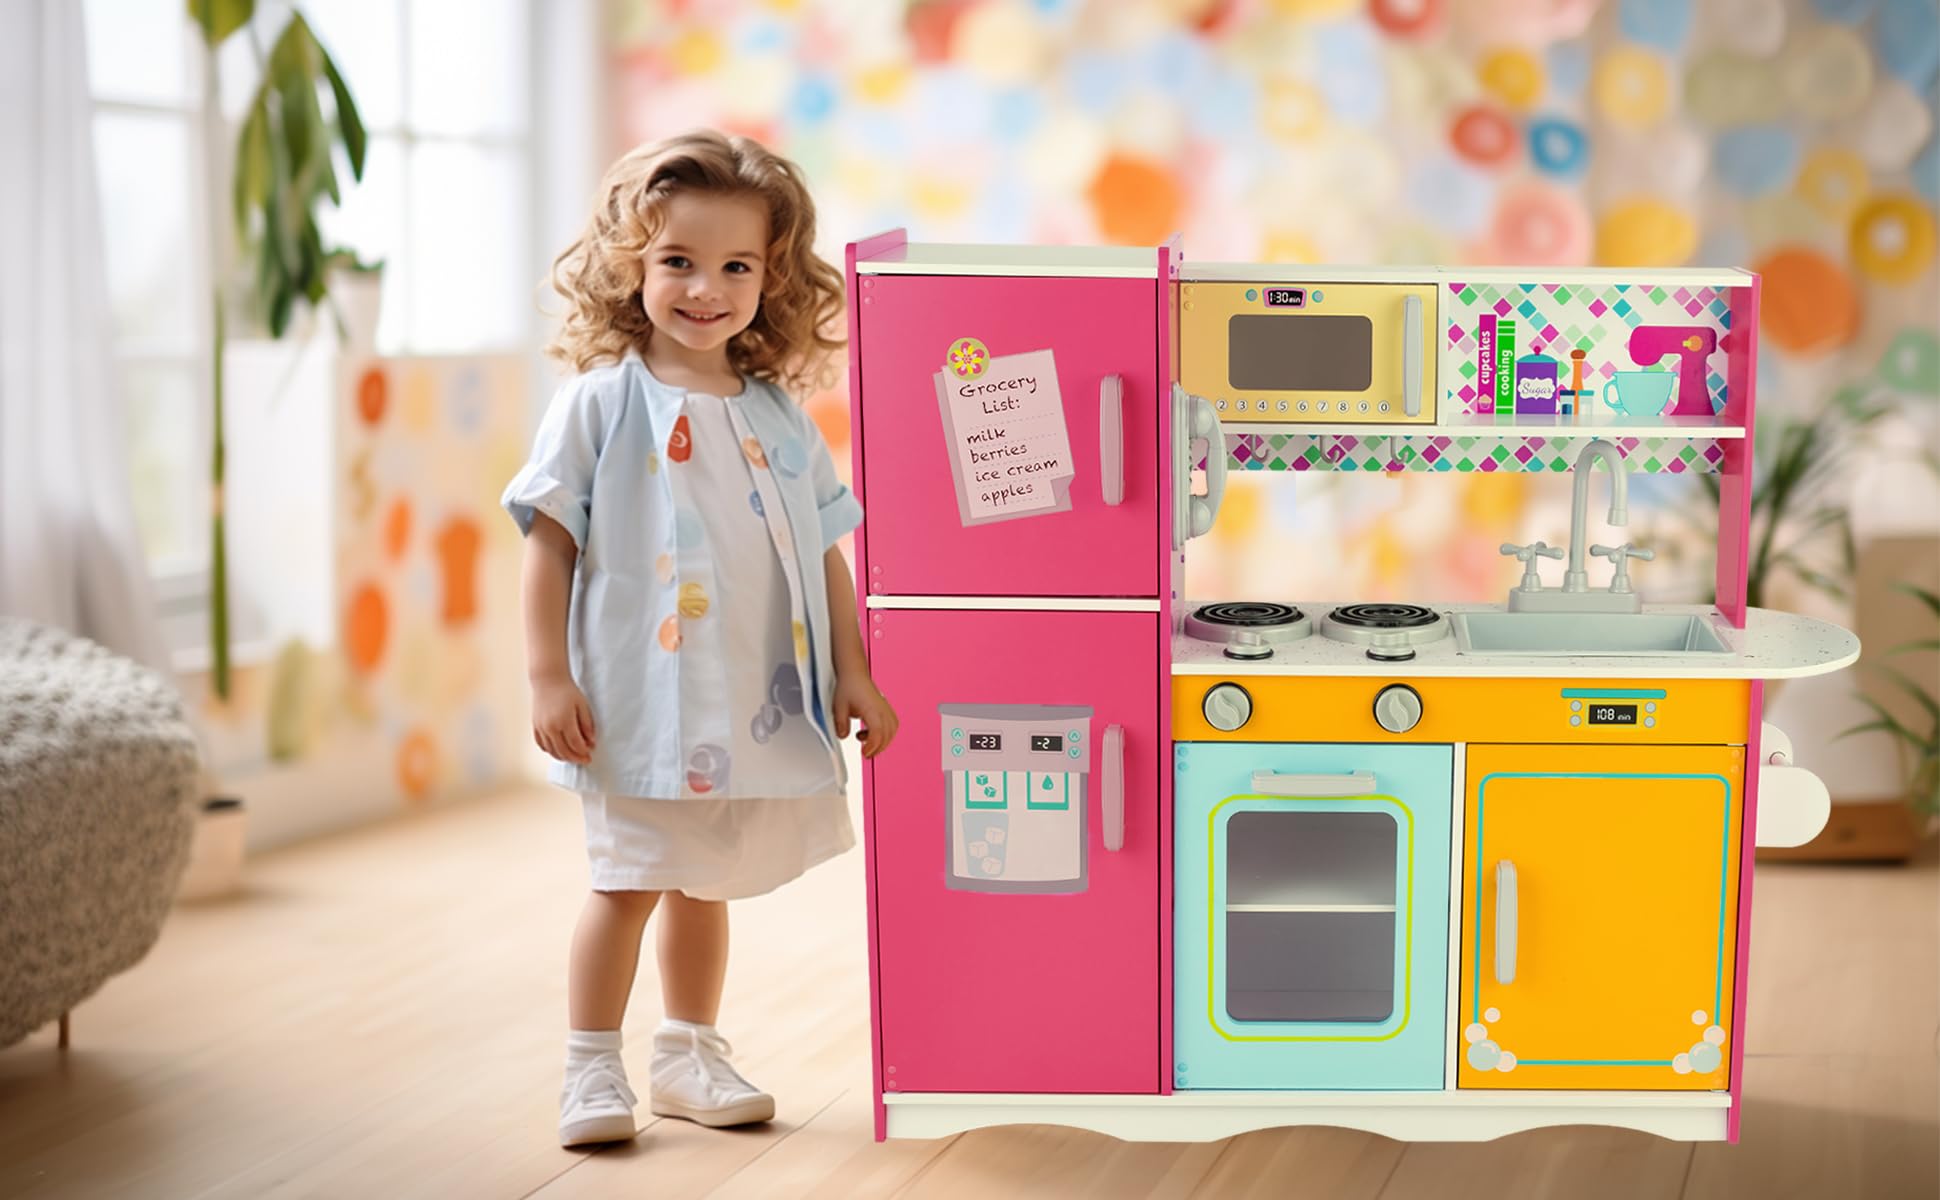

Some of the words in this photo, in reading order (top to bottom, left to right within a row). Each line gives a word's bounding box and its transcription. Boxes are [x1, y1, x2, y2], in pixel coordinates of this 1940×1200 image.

[1479, 330, 1492, 384] cupcakes
[1498, 349, 1513, 396] cooking
[959, 375, 1038, 398] Grocery
[1521, 382, 1552, 397] Sugar
[982, 395, 1021, 415] List:
[966, 427, 1006, 444] milk
[969, 443, 1028, 464] berries
[975, 467, 1001, 483] ice
[1006, 458, 1059, 477] cream
[981, 482, 1034, 507] apples
[1597, 708, 1615, 720] 108
[975, 736, 996, 748] -23
